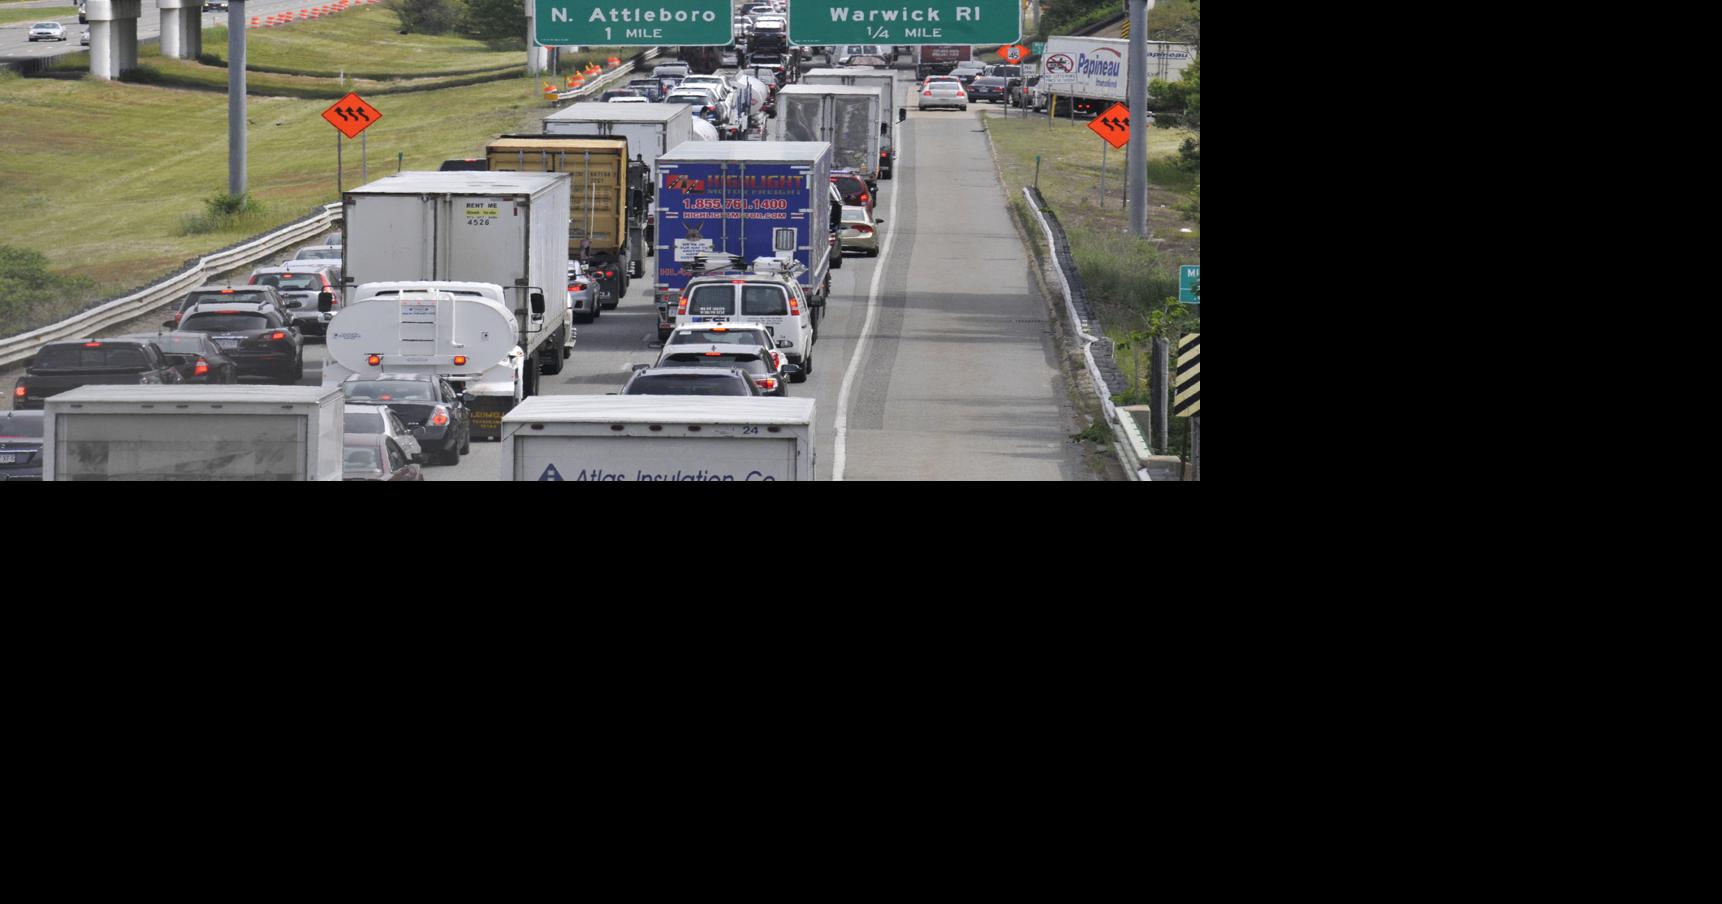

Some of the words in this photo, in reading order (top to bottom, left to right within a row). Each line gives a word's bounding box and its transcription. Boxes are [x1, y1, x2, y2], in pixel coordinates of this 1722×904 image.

[551, 7, 573, 22] N.
[588, 7, 716, 22] Attleboro
[829, 7, 941, 22] Warwick
[956, 7, 981, 21] RI
[604, 27, 612, 40] 1
[625, 28, 663, 39] MILE
[866, 26, 889, 39] 1/4
[904, 28, 942, 38] MILE
[1146, 51, 1189, 59] apineau
[1077, 53, 1121, 78] Papineau
[682, 198, 788, 210] 1.855.761.1400
[743, 426, 758, 435] 24
[576, 469, 625, 481] Atlas
[637, 469, 738, 481] Insulation
